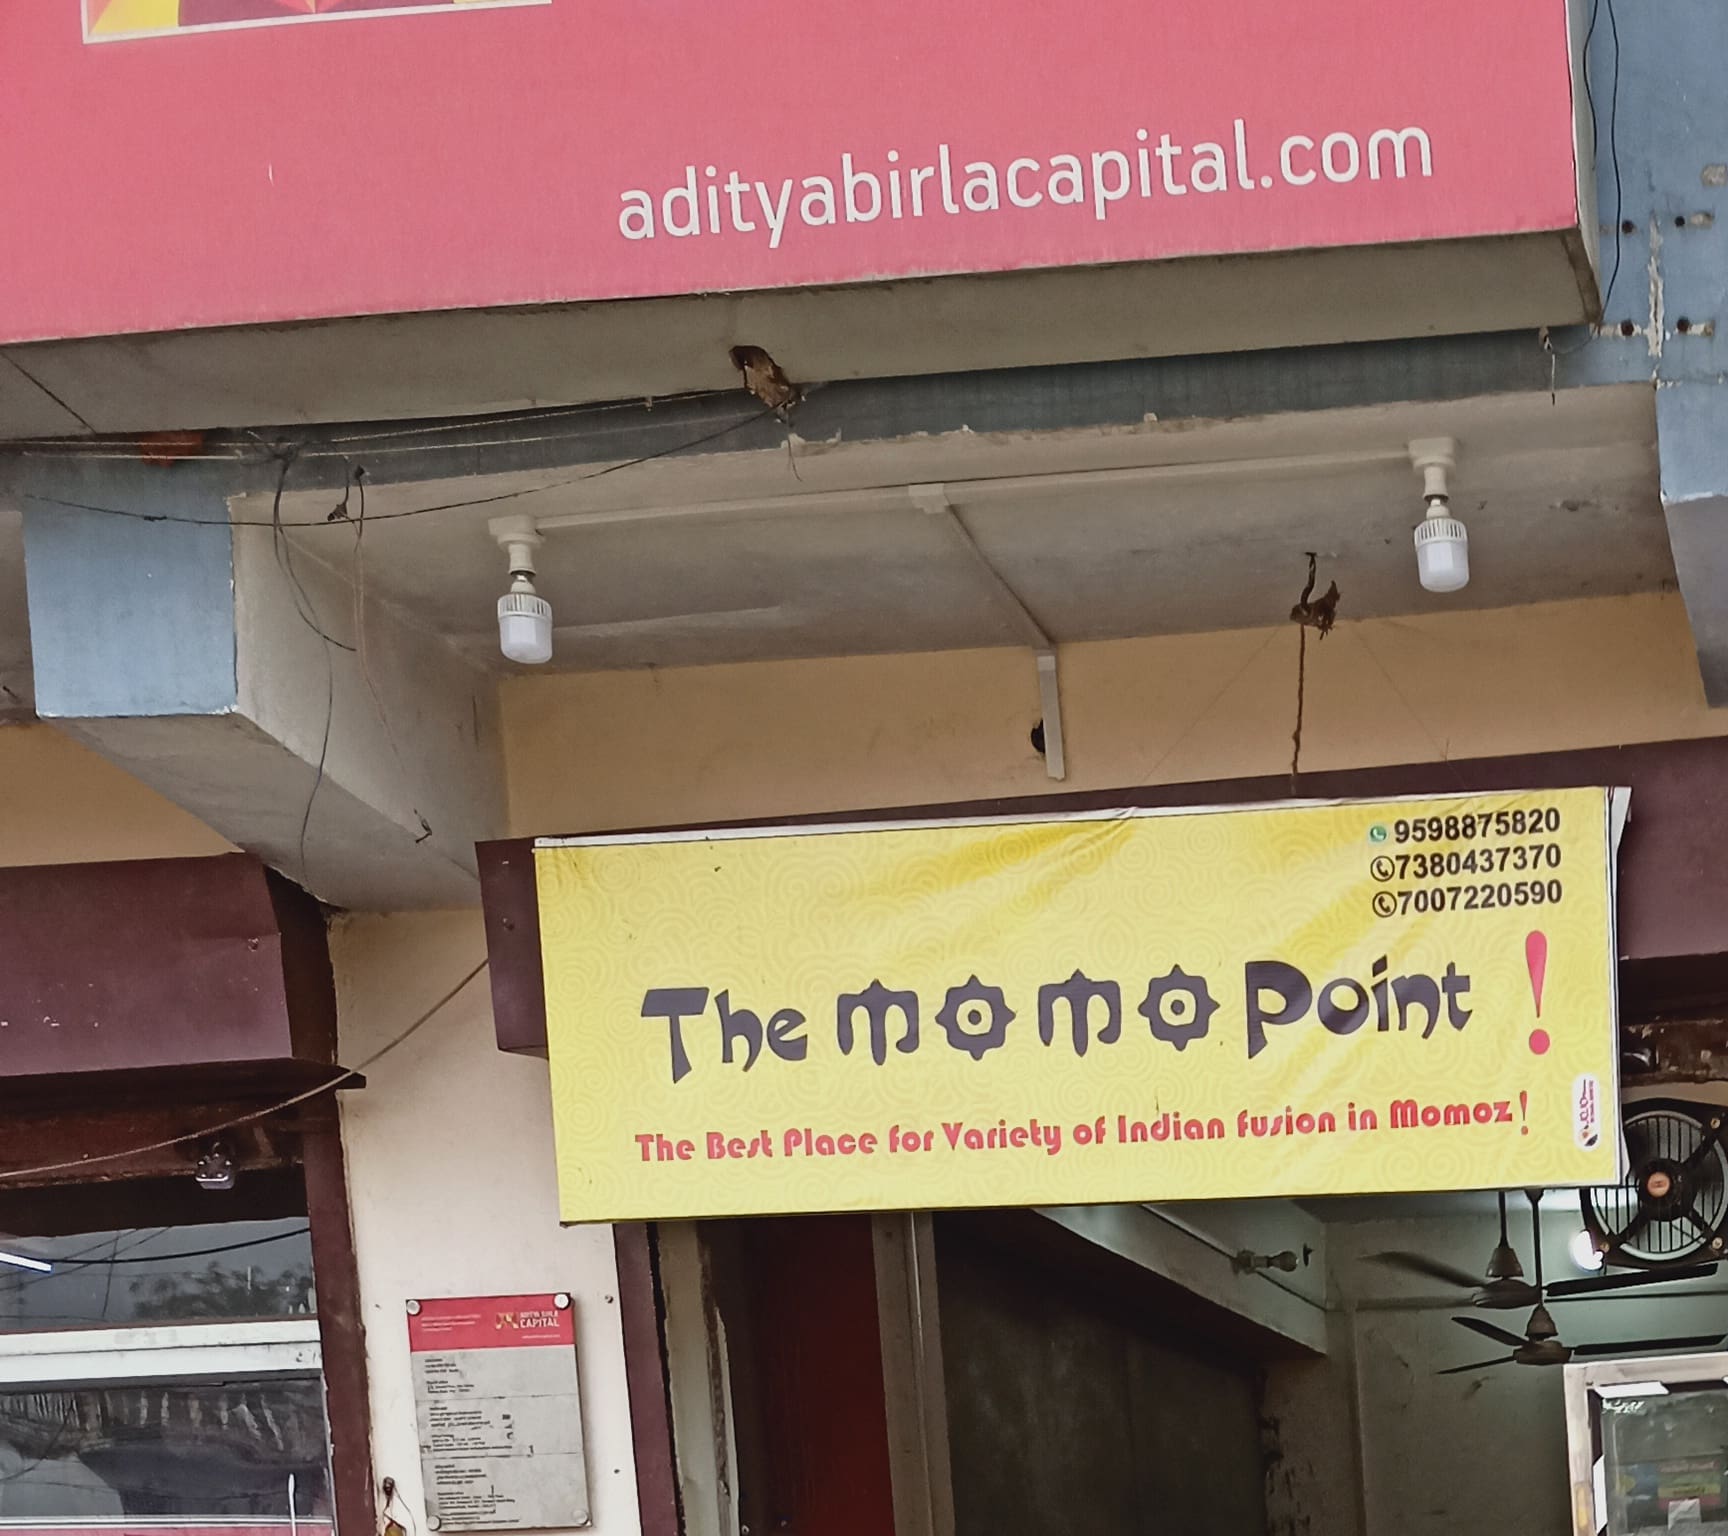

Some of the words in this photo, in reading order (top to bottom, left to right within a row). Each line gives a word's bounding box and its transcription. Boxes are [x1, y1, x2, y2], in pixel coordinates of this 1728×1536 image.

[618, 118, 1434, 250] adityabirlacapital.com
[1394, 807, 1561, 844] 9598875820
[1395, 843, 1562, 880] 7380437370
[1397, 878, 1563, 916] 7007220590
[640, 985, 808, 1084] The
[1244, 953, 1474, 1061] Point
[635, 1133, 695, 1162] The
[706, 1129, 774, 1160] Best
[783, 1127, 879, 1157] Place
[888, 1124, 935, 1153] for
[941, 1118, 1062, 1156] Variety
[1072, 1115, 1107, 1145] of
[1117, 1110, 1226, 1143] Indian
[1347, 1101, 1378, 1131] in
